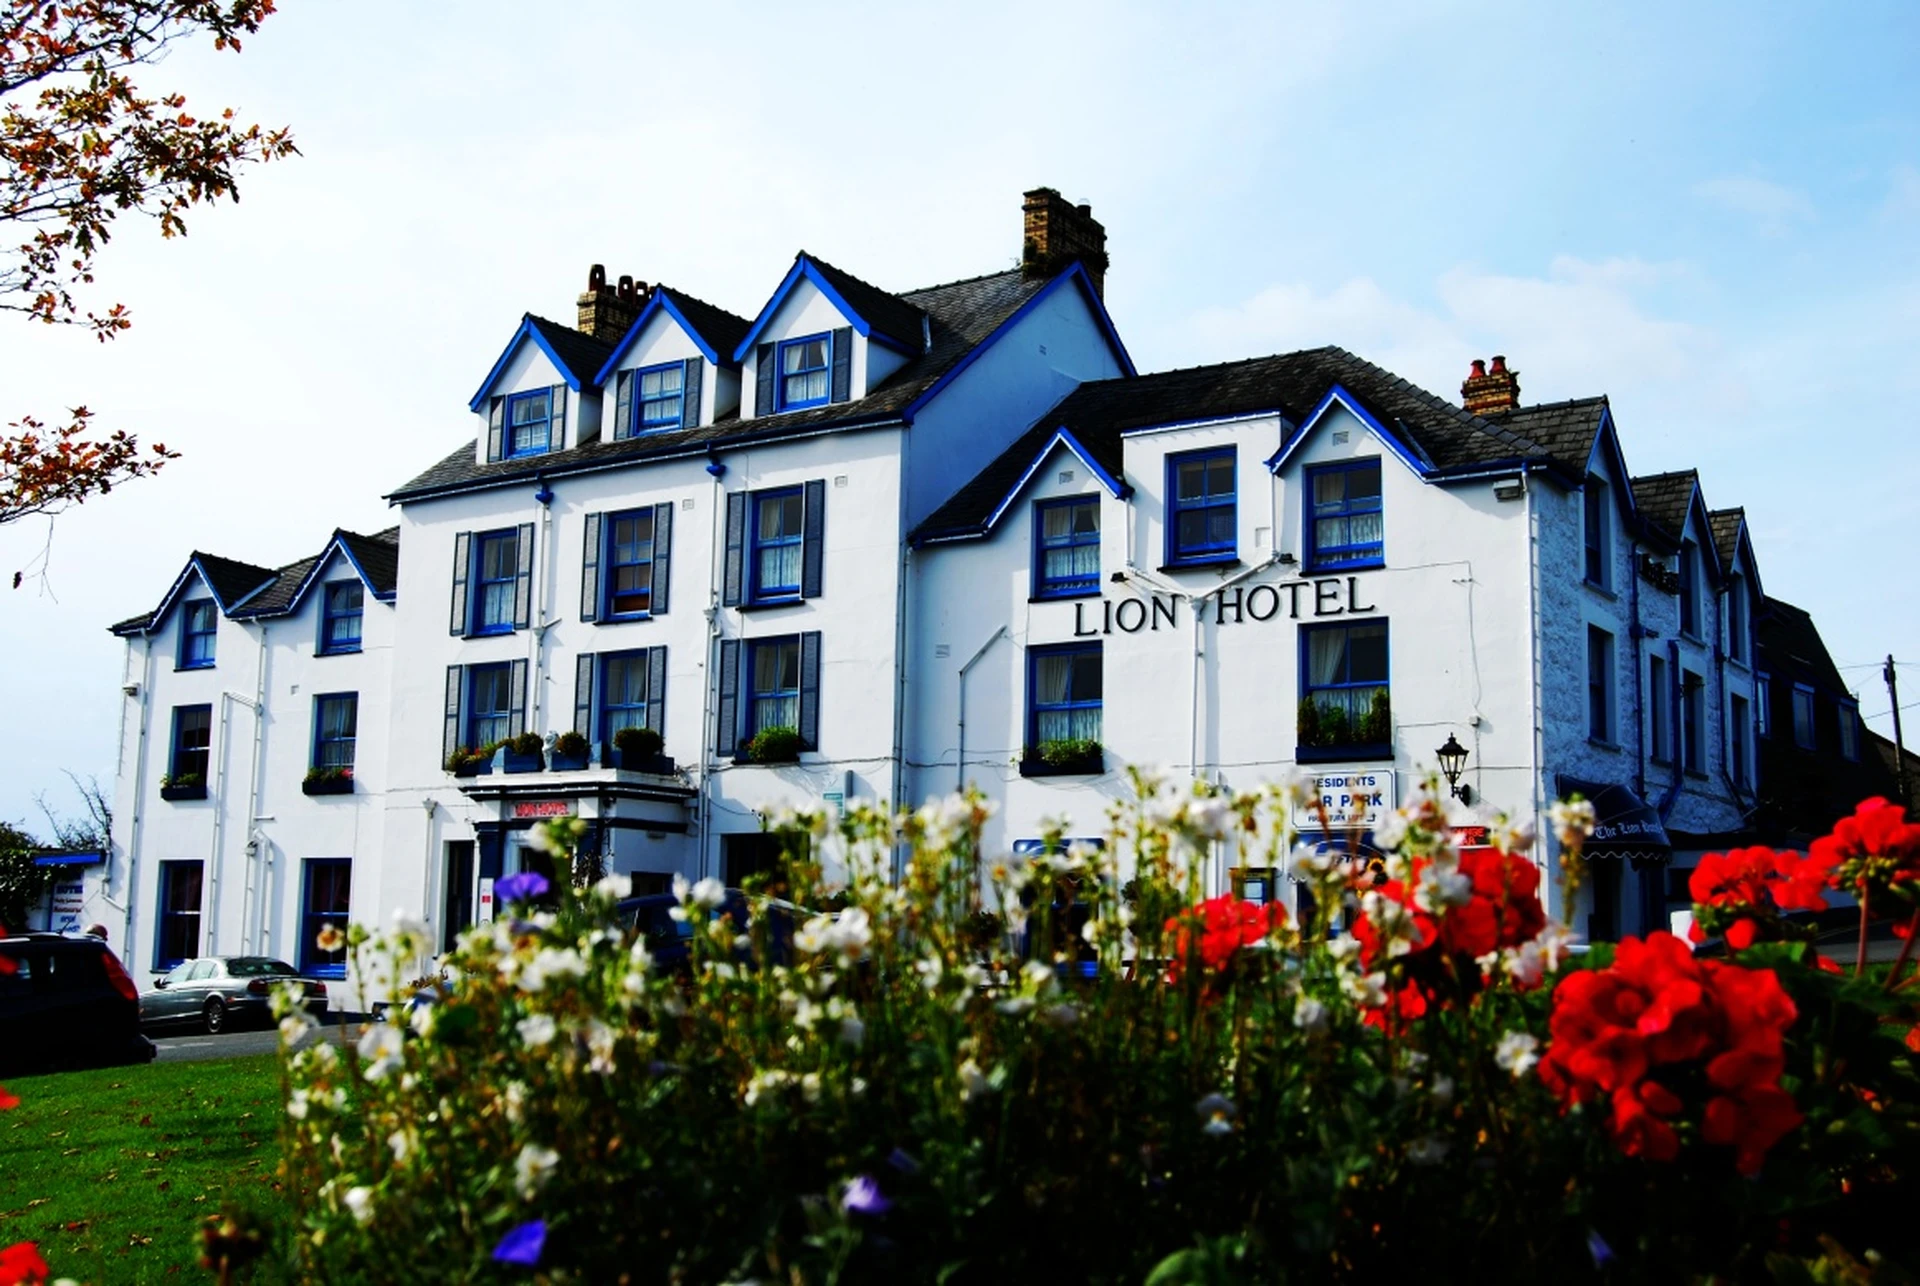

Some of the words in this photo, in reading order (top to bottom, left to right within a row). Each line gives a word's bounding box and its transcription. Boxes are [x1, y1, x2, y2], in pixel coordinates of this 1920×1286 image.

[1074, 594, 1179, 636] LION
[1215, 577, 1376, 625] HOTEL
[1311, 776, 1376, 788] ESIDENTS
